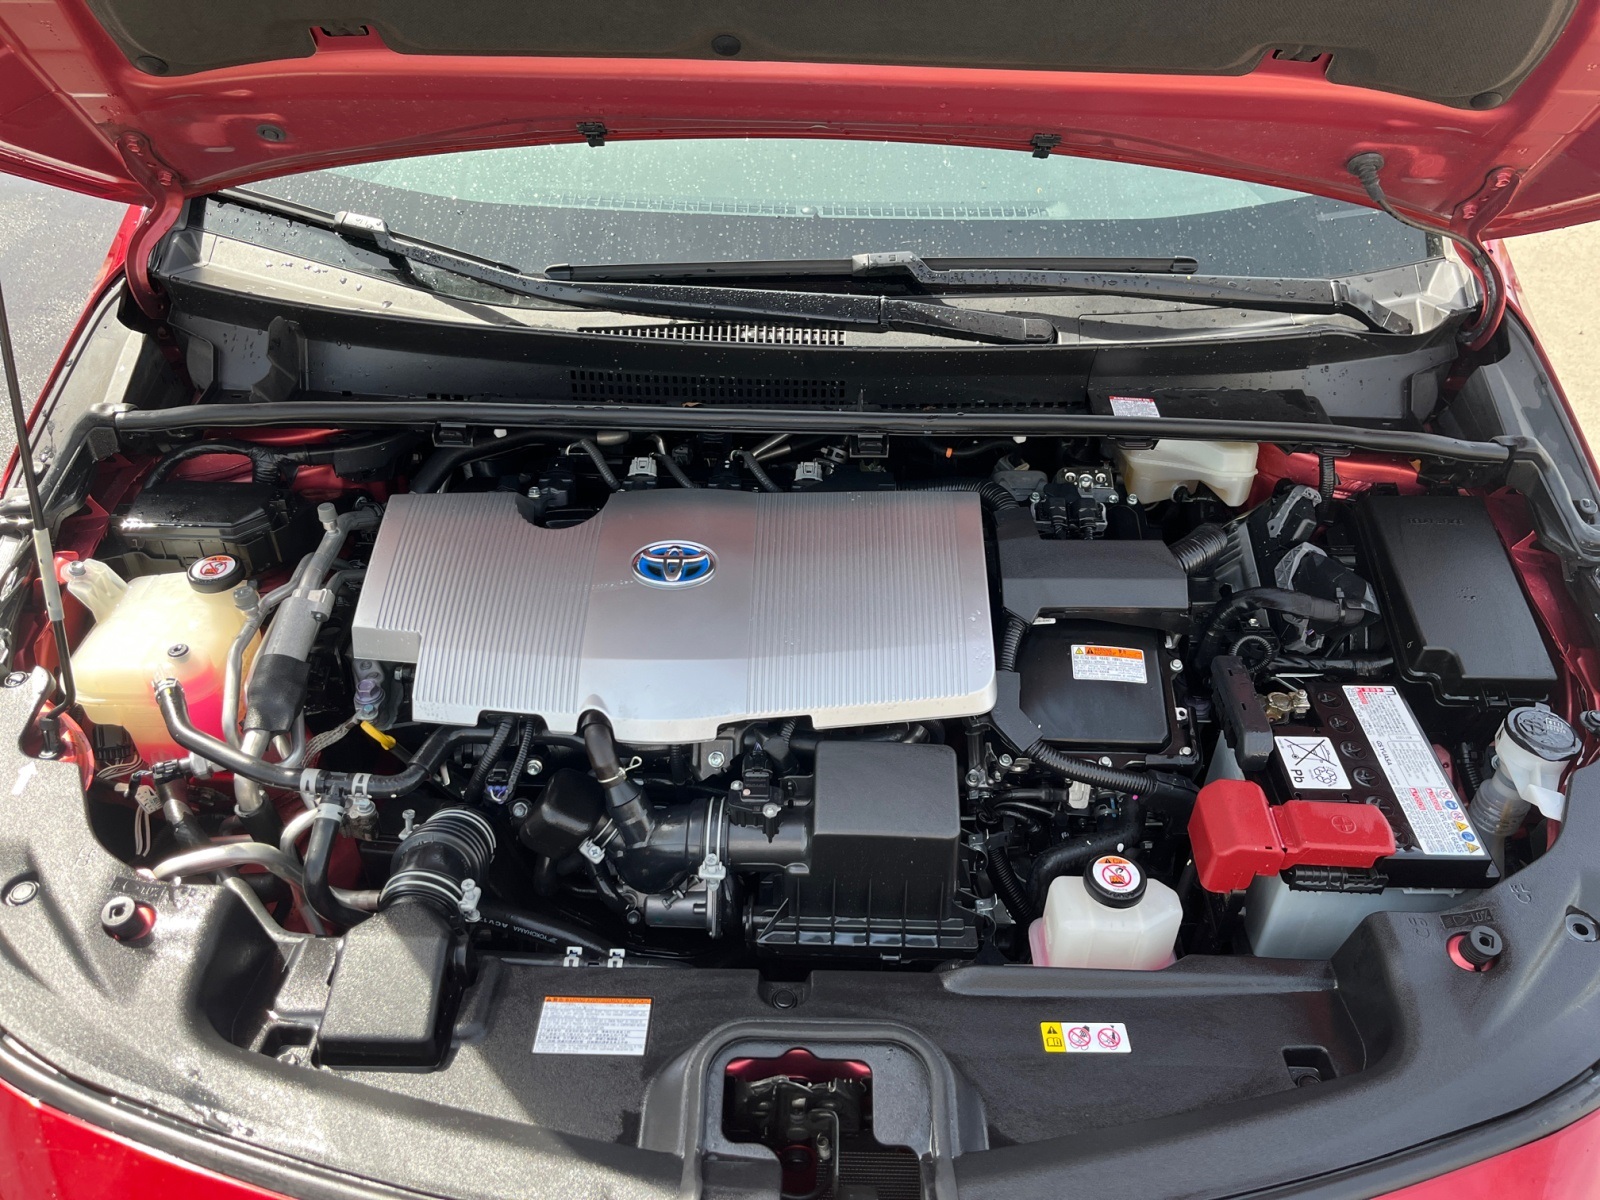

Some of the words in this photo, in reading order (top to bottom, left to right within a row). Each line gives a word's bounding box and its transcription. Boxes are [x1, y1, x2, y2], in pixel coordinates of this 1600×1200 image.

[1379, 747, 1393, 765] YUASA
[1291, 768, 1304, 784] Pb
[513, 925, 548, 941] YOKOHAMA
